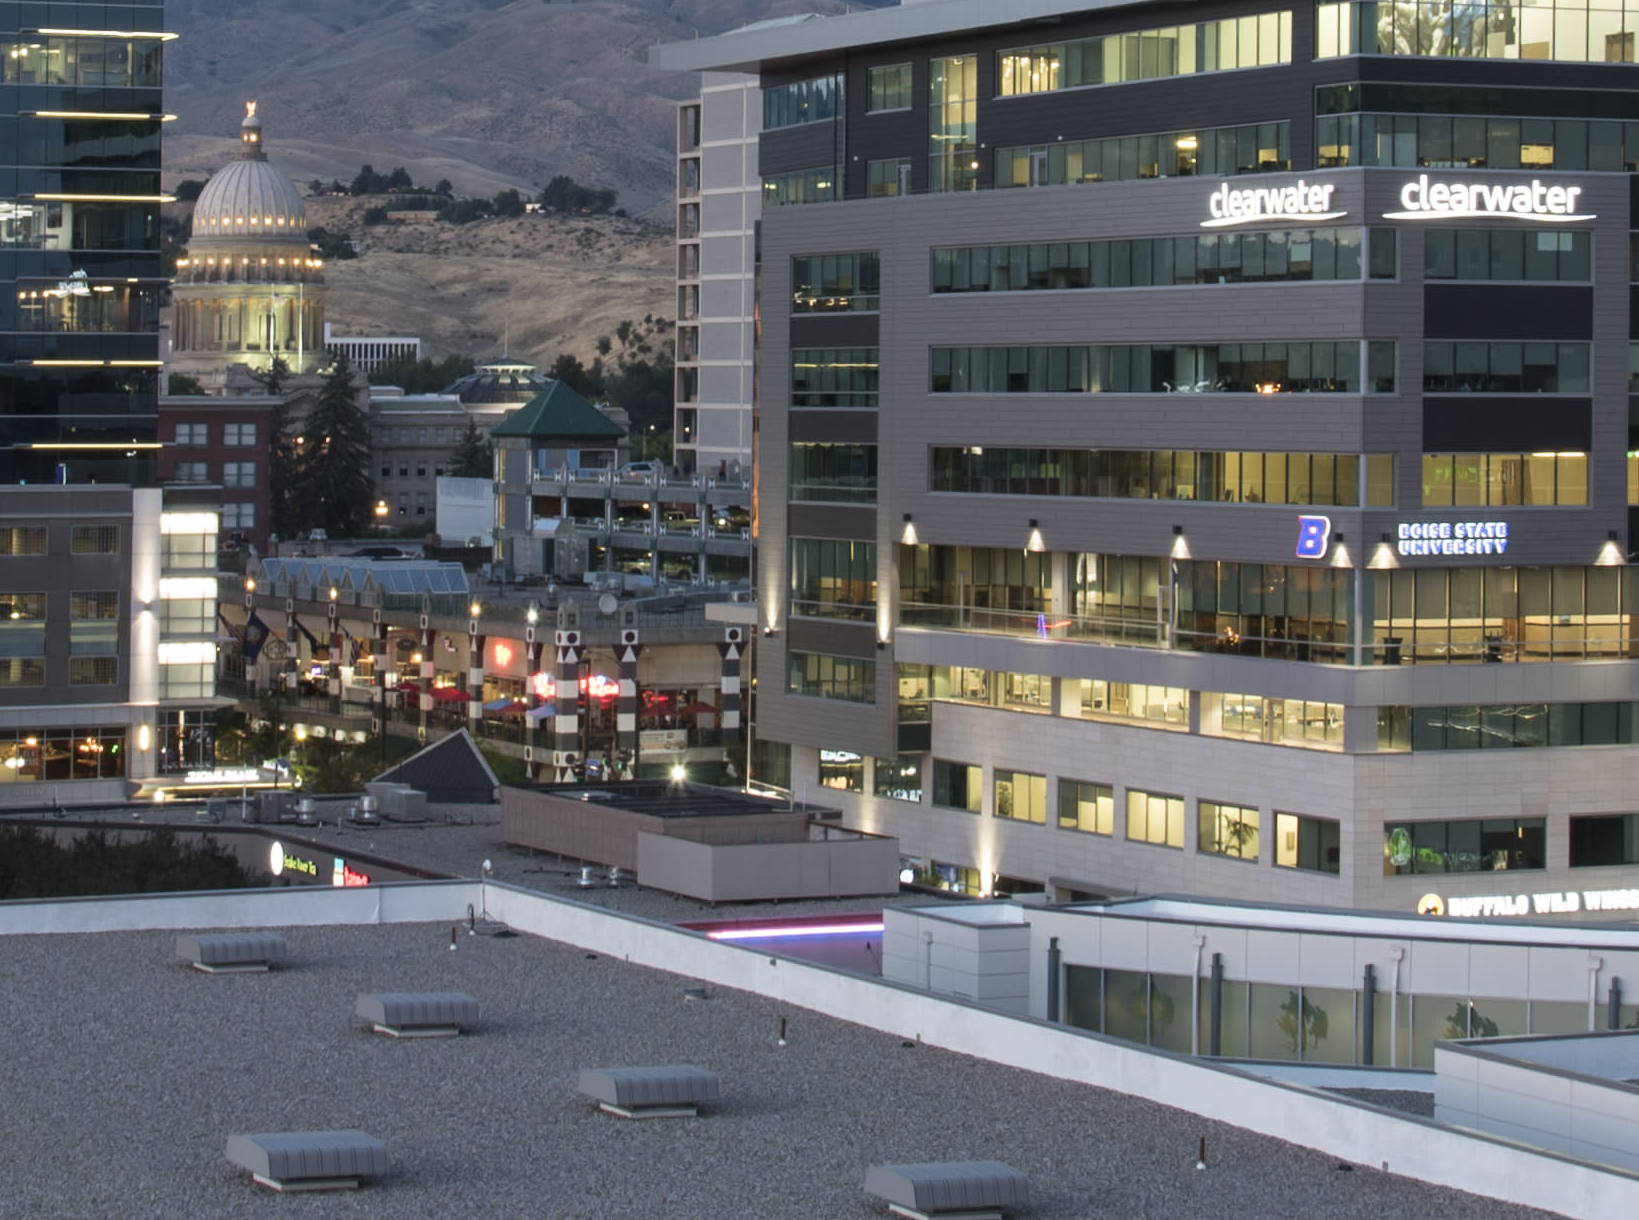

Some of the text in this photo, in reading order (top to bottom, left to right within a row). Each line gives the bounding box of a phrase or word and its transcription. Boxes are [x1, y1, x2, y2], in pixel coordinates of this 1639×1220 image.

[1209, 179, 1335, 218] clearwater
[1401, 174, 1582, 214] clearwater
[1296, 514, 1332, 560] B
[1397, 538, 1508, 556] UNIVERSITY
[1398, 522, 1509, 540] BOISE STATE
